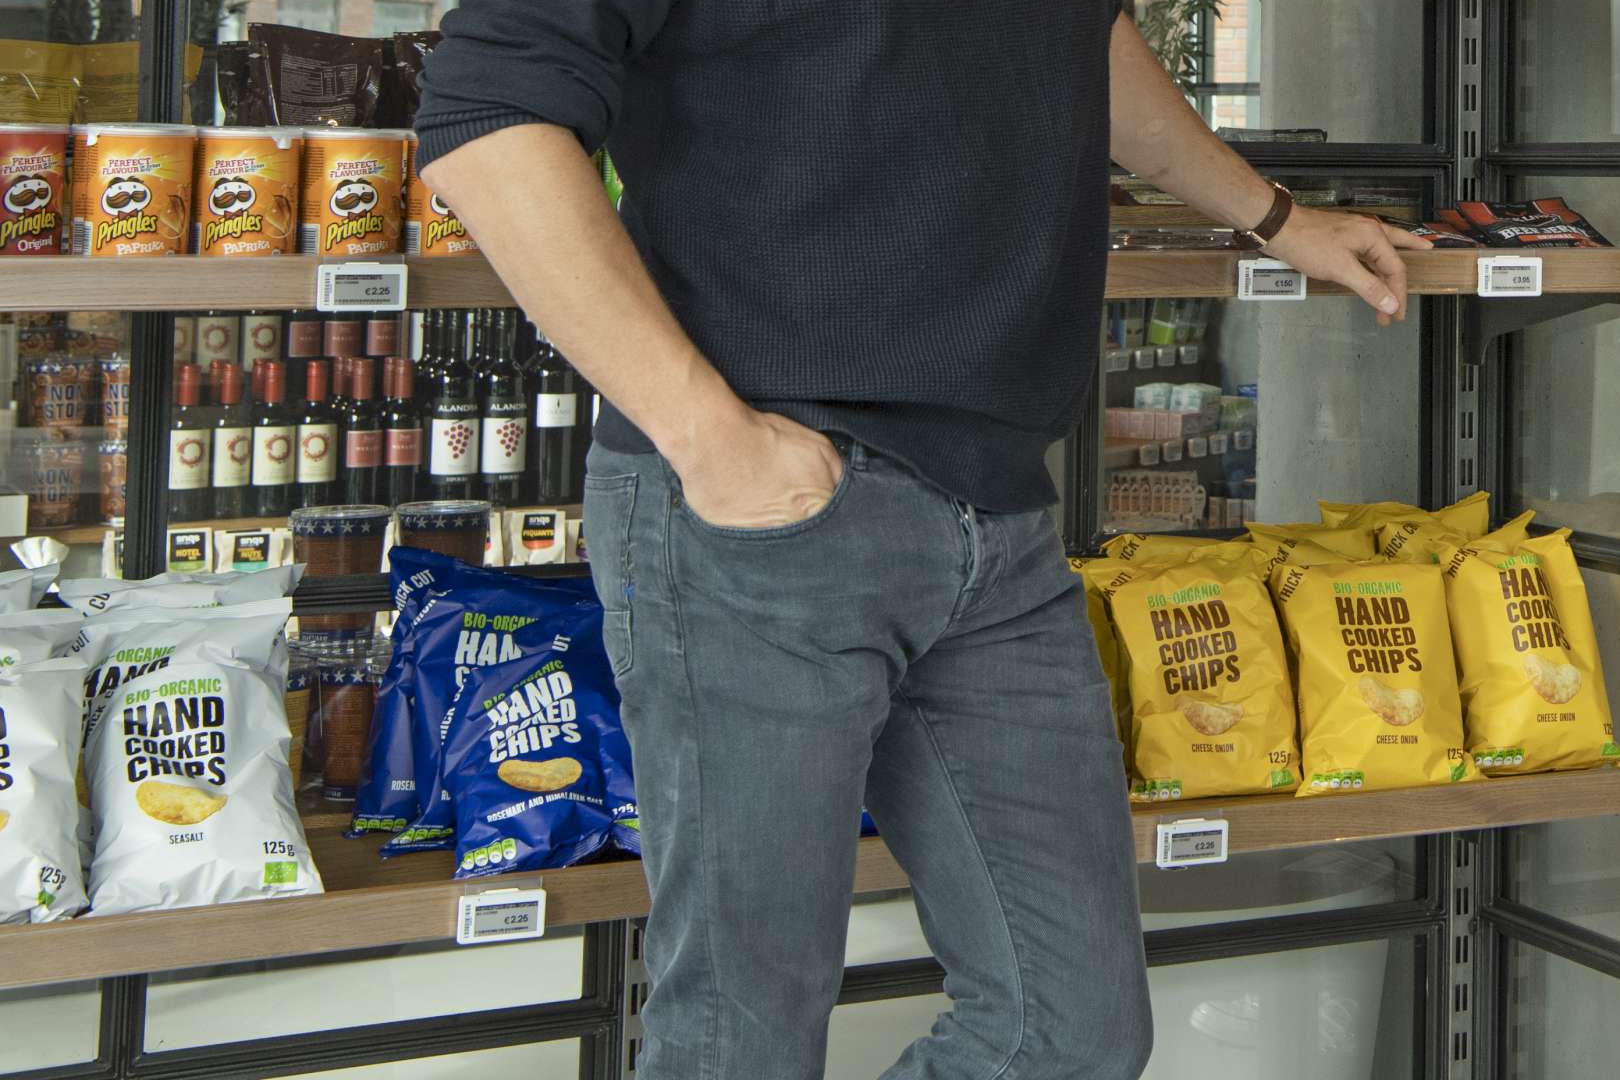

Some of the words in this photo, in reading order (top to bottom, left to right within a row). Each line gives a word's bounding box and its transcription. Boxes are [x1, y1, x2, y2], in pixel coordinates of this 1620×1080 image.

[12, 155, 51, 166] PERFECT
[108, 157, 152, 167] PERFECT
[215, 158, 256, 168] PERFECT
[337, 160, 378, 170] PERFECT
[3, 164, 45, 175] FLAVOUR
[102, 166, 139, 176] FLAVOUR
[208, 167, 245, 177] FLAVOUR
[330, 168, 369, 179] FLAVOUR
[0, 210, 56, 248] Pringles
[97, 211, 157, 250] Pringles
[205, 211, 263, 250] Pringles
[325, 212, 384, 251] Pringles
[426, 217, 466, 248] Pring
[1498, 226, 1538, 240] BEEF
[18, 236, 53, 252] Original
[116, 241, 165, 255] PAPRIKA
[223, 241, 271, 255] PAPRIKA
[447, 240, 478, 253] PAPR
[365, 287, 391, 296] €2.25
[108, 384, 129, 400] NO
[105, 404, 129, 418] STO
[411, 569, 436, 589] CUT
[1499, 566, 1553, 600] HAN
[1147, 583, 1223, 608] BIO-ORGANIC
[1335, 597, 1410, 626] HAND
[1150, 599, 1231, 642] HAND
[1341, 626, 1417, 648] COOKED
[454, 630, 523, 666] HAN
[1159, 630, 1238, 666] COOKED
[1347, 648, 1423, 674] CHIPS
[1163, 654, 1241, 696] CHIPS
[125, 678, 222, 705] BIO-ORGANIC
[123, 696, 225, 738] HAND
[1536, 713, 1558, 723] CHEESE
[1559, 712, 1576, 722] ONION
[125, 731, 225, 760] COOKED
[489, 722, 582, 763] CHIPS
[1191, 743, 1214, 753] CHEESE
[1215, 743, 1235, 753] ONION
[1376, 735, 1399, 745] CHEESE
[1400, 735, 1419, 745] ONION
[127, 756, 226, 786] CHIPS
[487, 801, 526, 823] ROSEMARY
[528, 795, 544, 809] AND
[169, 832, 204, 845] SEASALT
[263, 840, 295, 857] 125g
[504, 914, 529, 925] €2.25
